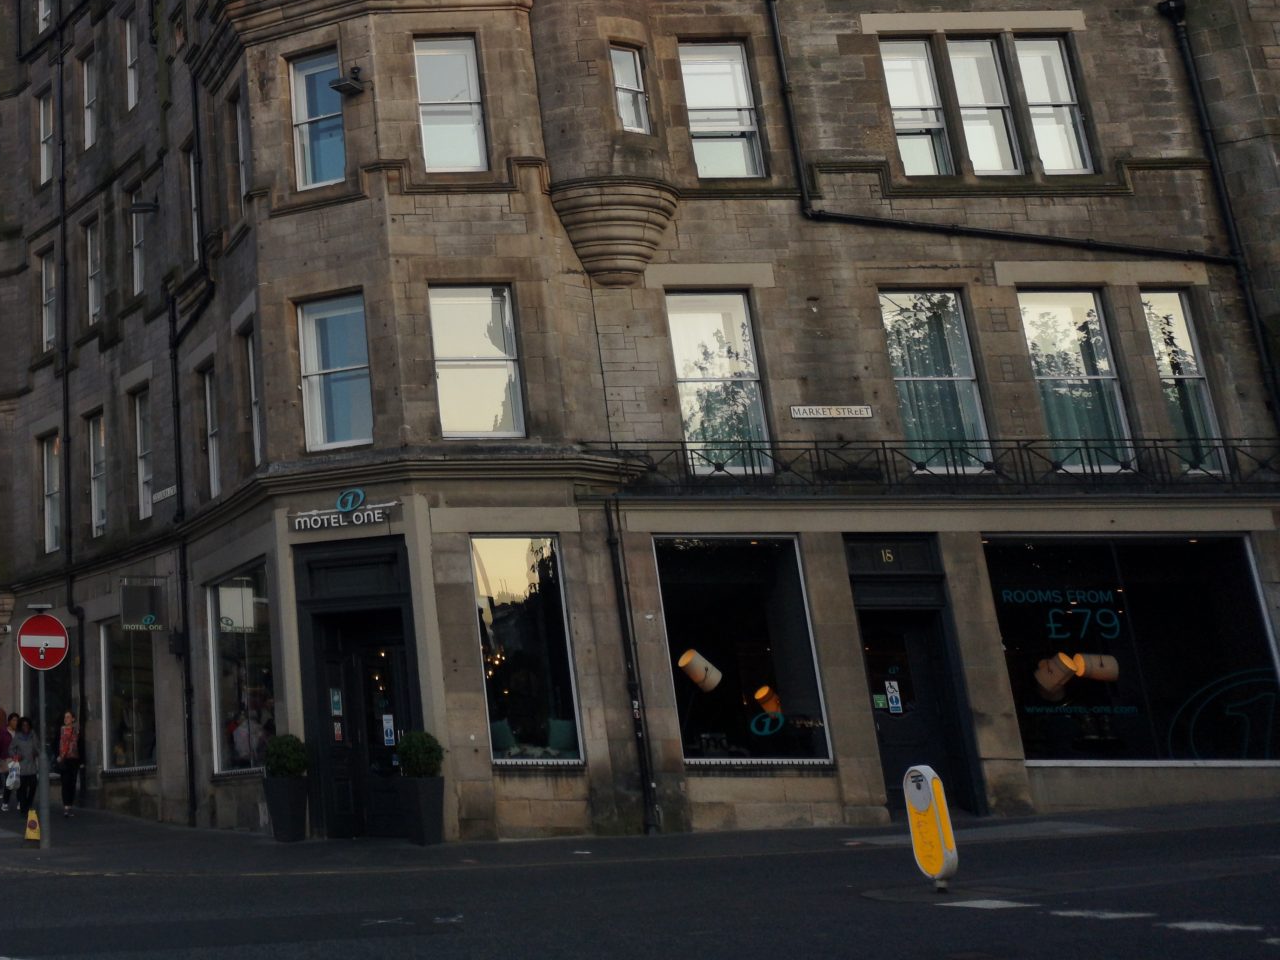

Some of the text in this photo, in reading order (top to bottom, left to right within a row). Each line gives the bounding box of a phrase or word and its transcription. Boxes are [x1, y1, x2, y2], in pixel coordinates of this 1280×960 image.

[792, 407, 869, 416] MARKET STREET
[295, 510, 383, 530] MOTEL ONE
[1002, 590, 1114, 603] ROOMS FROM
[1046, 608, 1121, 639] £79
